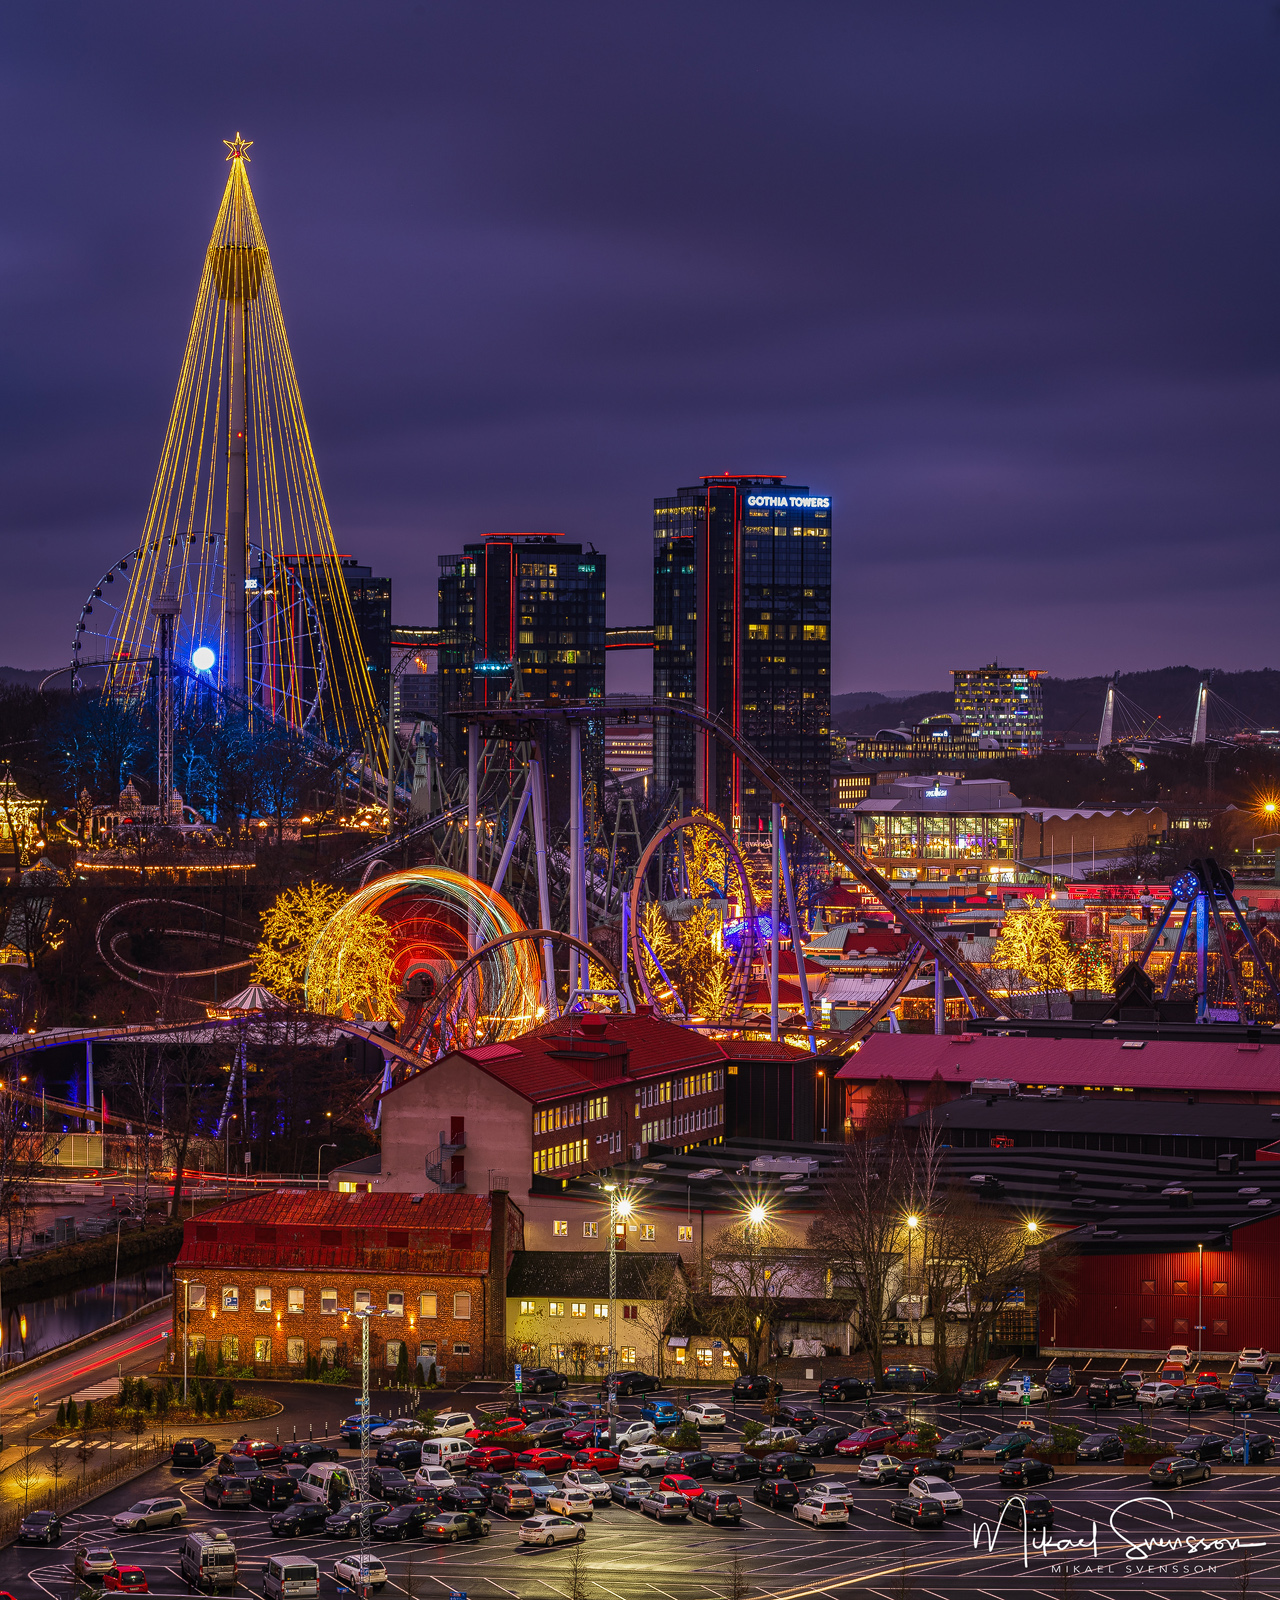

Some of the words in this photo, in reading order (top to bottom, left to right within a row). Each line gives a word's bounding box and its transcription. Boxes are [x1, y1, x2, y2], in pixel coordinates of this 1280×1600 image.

[748, 496, 788, 507] GOTHIA
[789, 497, 830, 508] TOWERS
[225, 1297, 232, 1306] P
